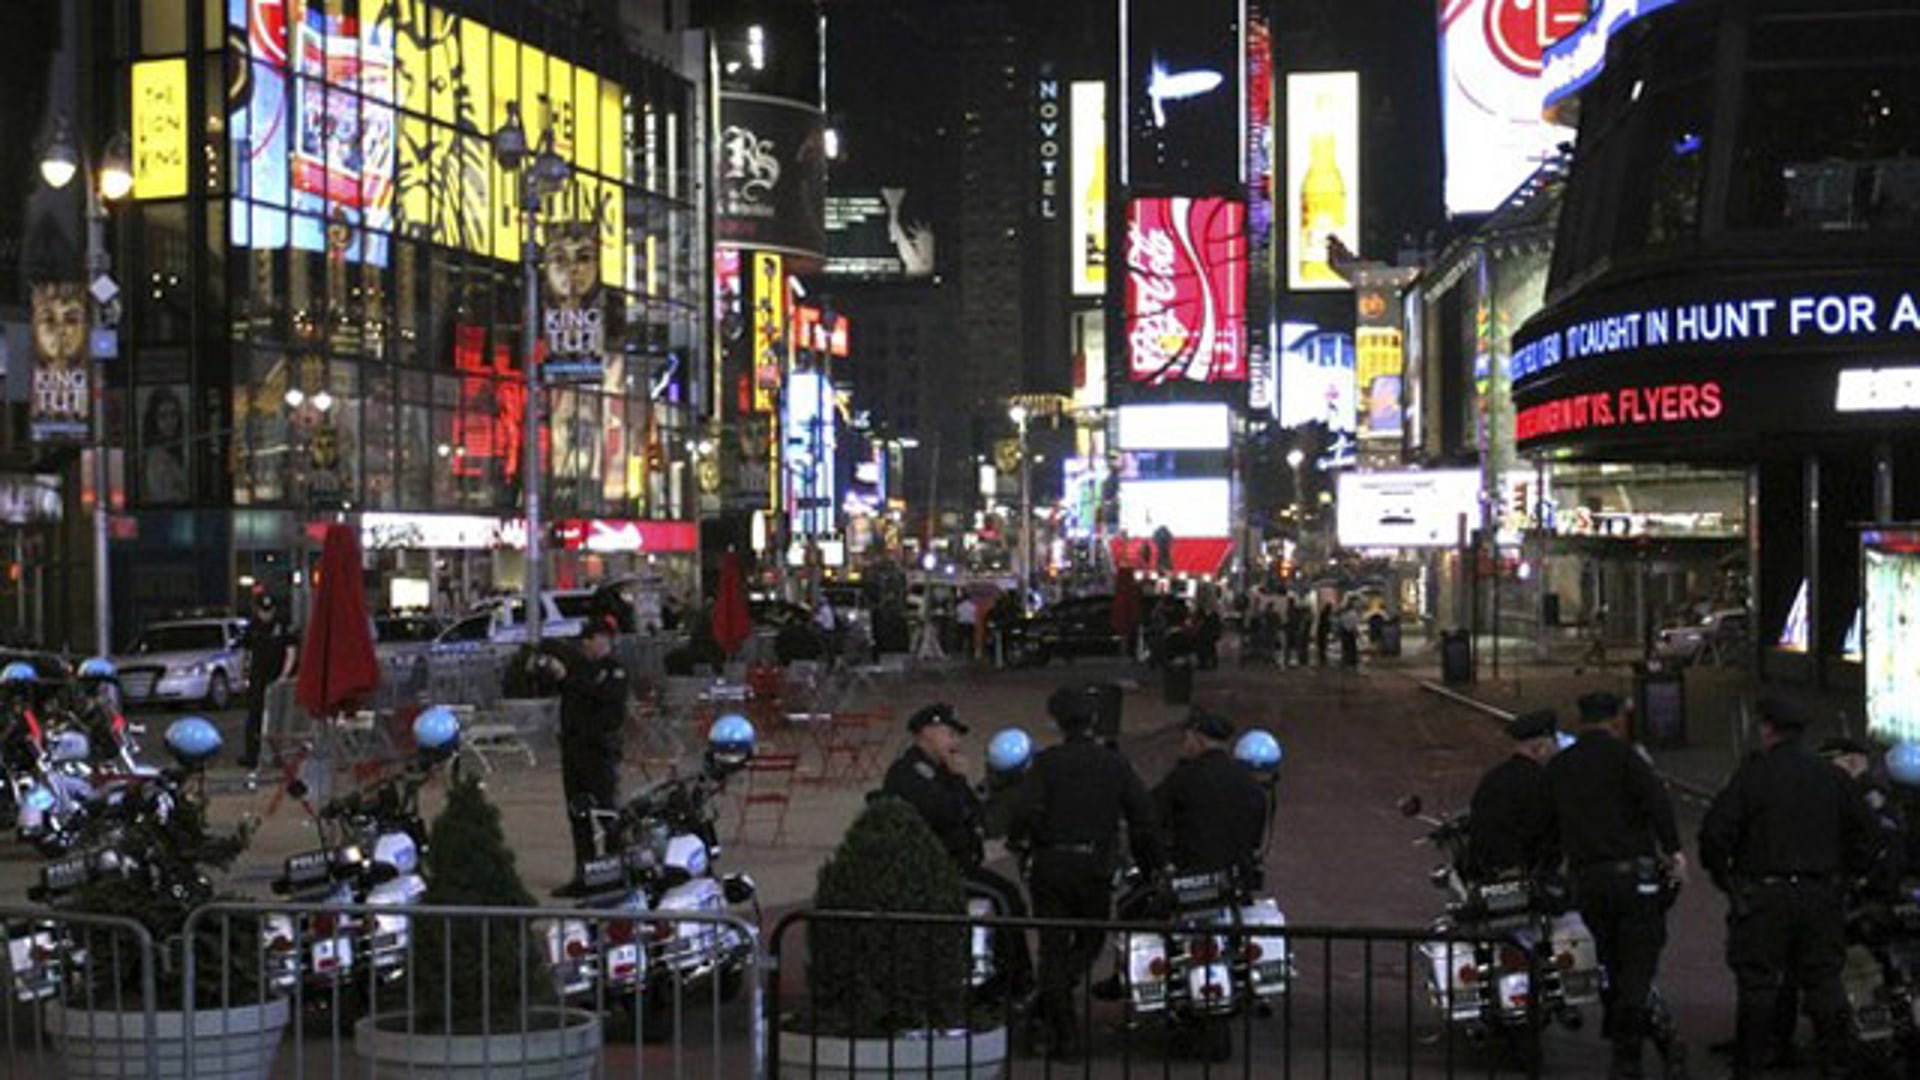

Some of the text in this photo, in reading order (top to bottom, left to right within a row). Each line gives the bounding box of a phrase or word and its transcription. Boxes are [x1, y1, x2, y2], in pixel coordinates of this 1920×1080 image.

[1039, 78, 1059, 220] NOVOTEL
[545, 309, 603, 332] KING
[1645, 308, 1669, 346] IN
[1676, 299, 1776, 342] HUNT
[1790, 296, 1877, 336] FOR
[550, 331, 604, 356] TUT
[32, 369, 88, 392] KING
[36, 391, 88, 418] TUT
[1618, 382, 1722, 423] FLYERS
